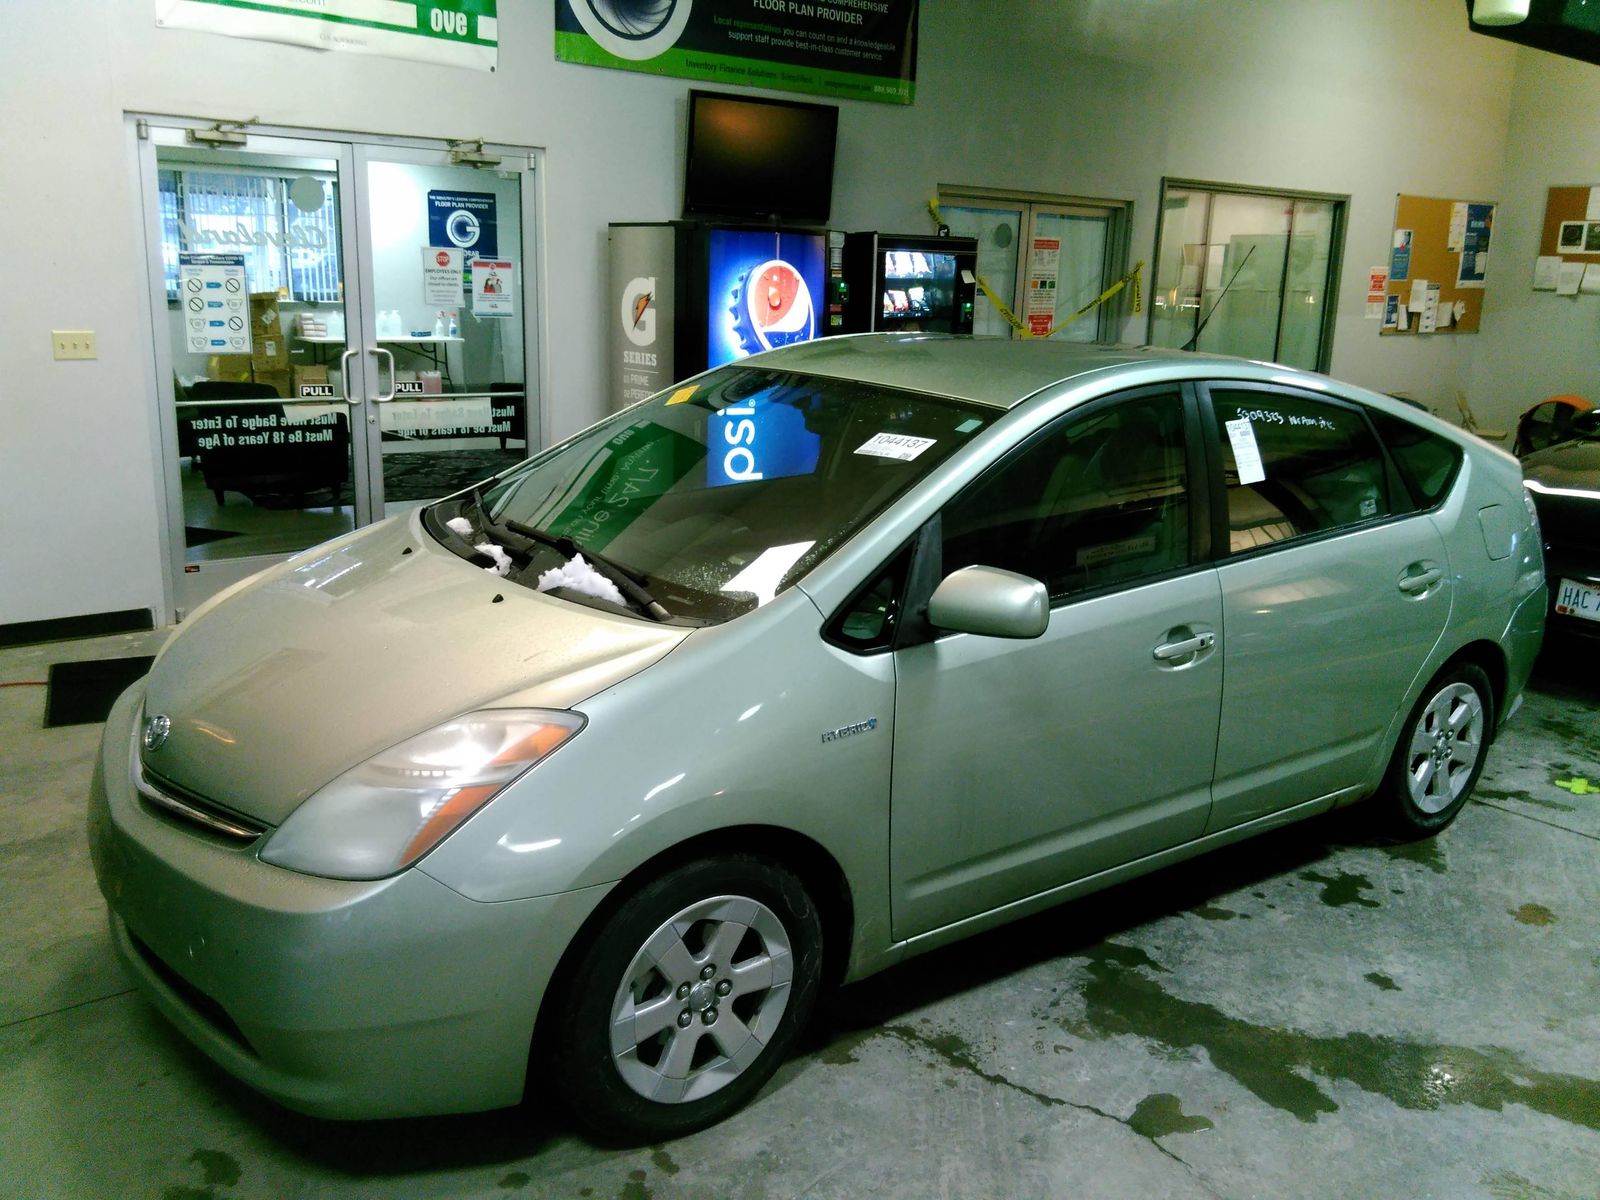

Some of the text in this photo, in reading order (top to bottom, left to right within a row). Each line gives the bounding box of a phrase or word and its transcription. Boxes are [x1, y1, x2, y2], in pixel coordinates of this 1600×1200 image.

[753, 0, 863, 25] FLOOR PLAN PROVIDER
[430, 8, 467, 36] ove
[728, 31, 753, 42] support
[755, 34, 769, 44] staff
[771, 37, 794, 48] provide
[795, 41, 834, 54] best-in-class
[783, 27, 794, 37] you
[795, 29, 807, 38] can
[808, 31, 826, 42] count
[836, 35, 848, 45] and
[685, 58, 717, 72] Inventory
[720, 63, 745, 75] Finance
[623, 351, 657, 367] SERIES
[302, 386, 333, 397] PULL
[395, 383, 422, 393] PULL
[873, 435, 928, 449] 1044137
[1562, 586, 1591, 609] HAC
